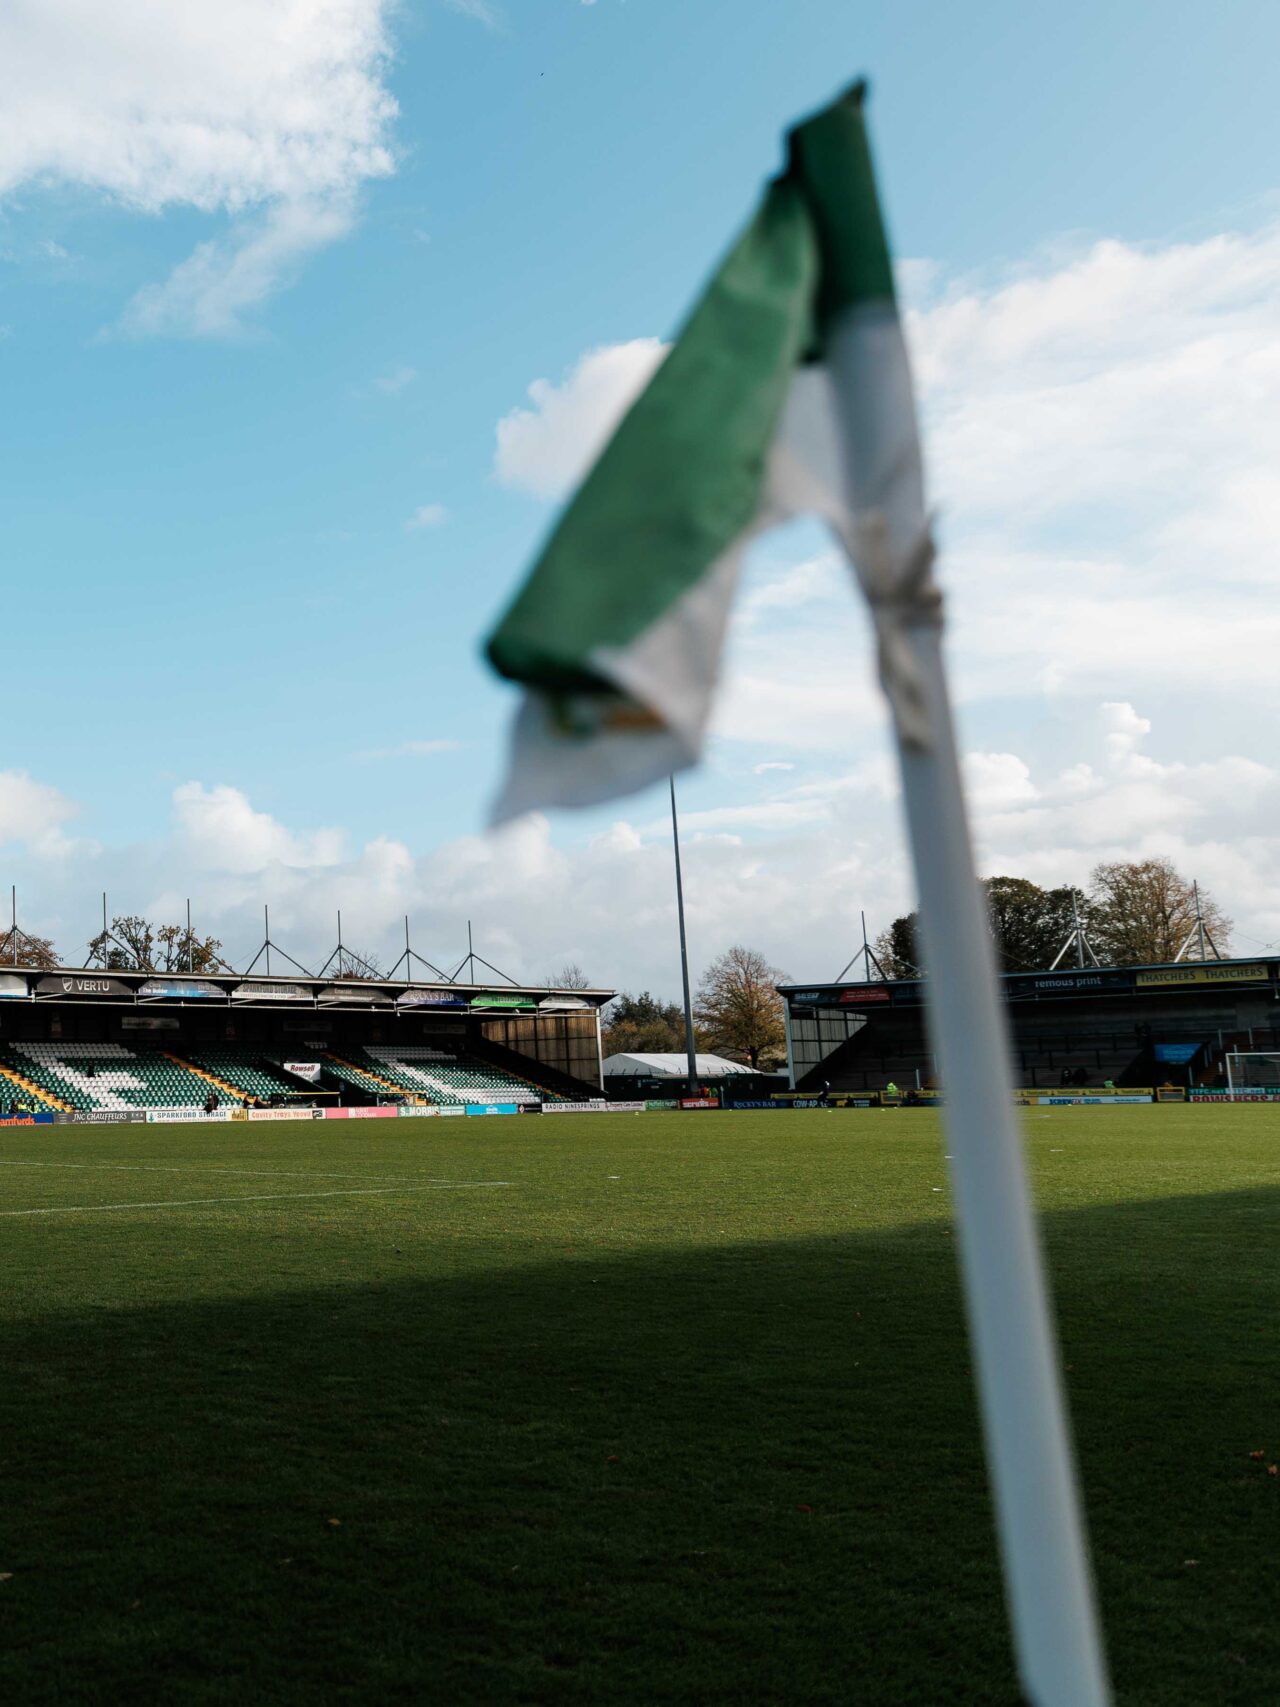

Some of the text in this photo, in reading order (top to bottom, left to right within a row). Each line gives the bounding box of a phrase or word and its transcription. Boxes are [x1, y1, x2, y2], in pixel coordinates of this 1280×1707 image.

[1140, 968, 1264, 983] THATCHERS THATCHERS
[76, 980, 110, 992] VERTU
[1034, 976, 1102, 989] remous print
[290, 1064, 316, 1072] Rowsell
[762, 1100, 777, 1108] BAR
[409, 1106, 440, 1116] MORRIS
[72, 1112, 128, 1122] JNC CHAUFFEURS
